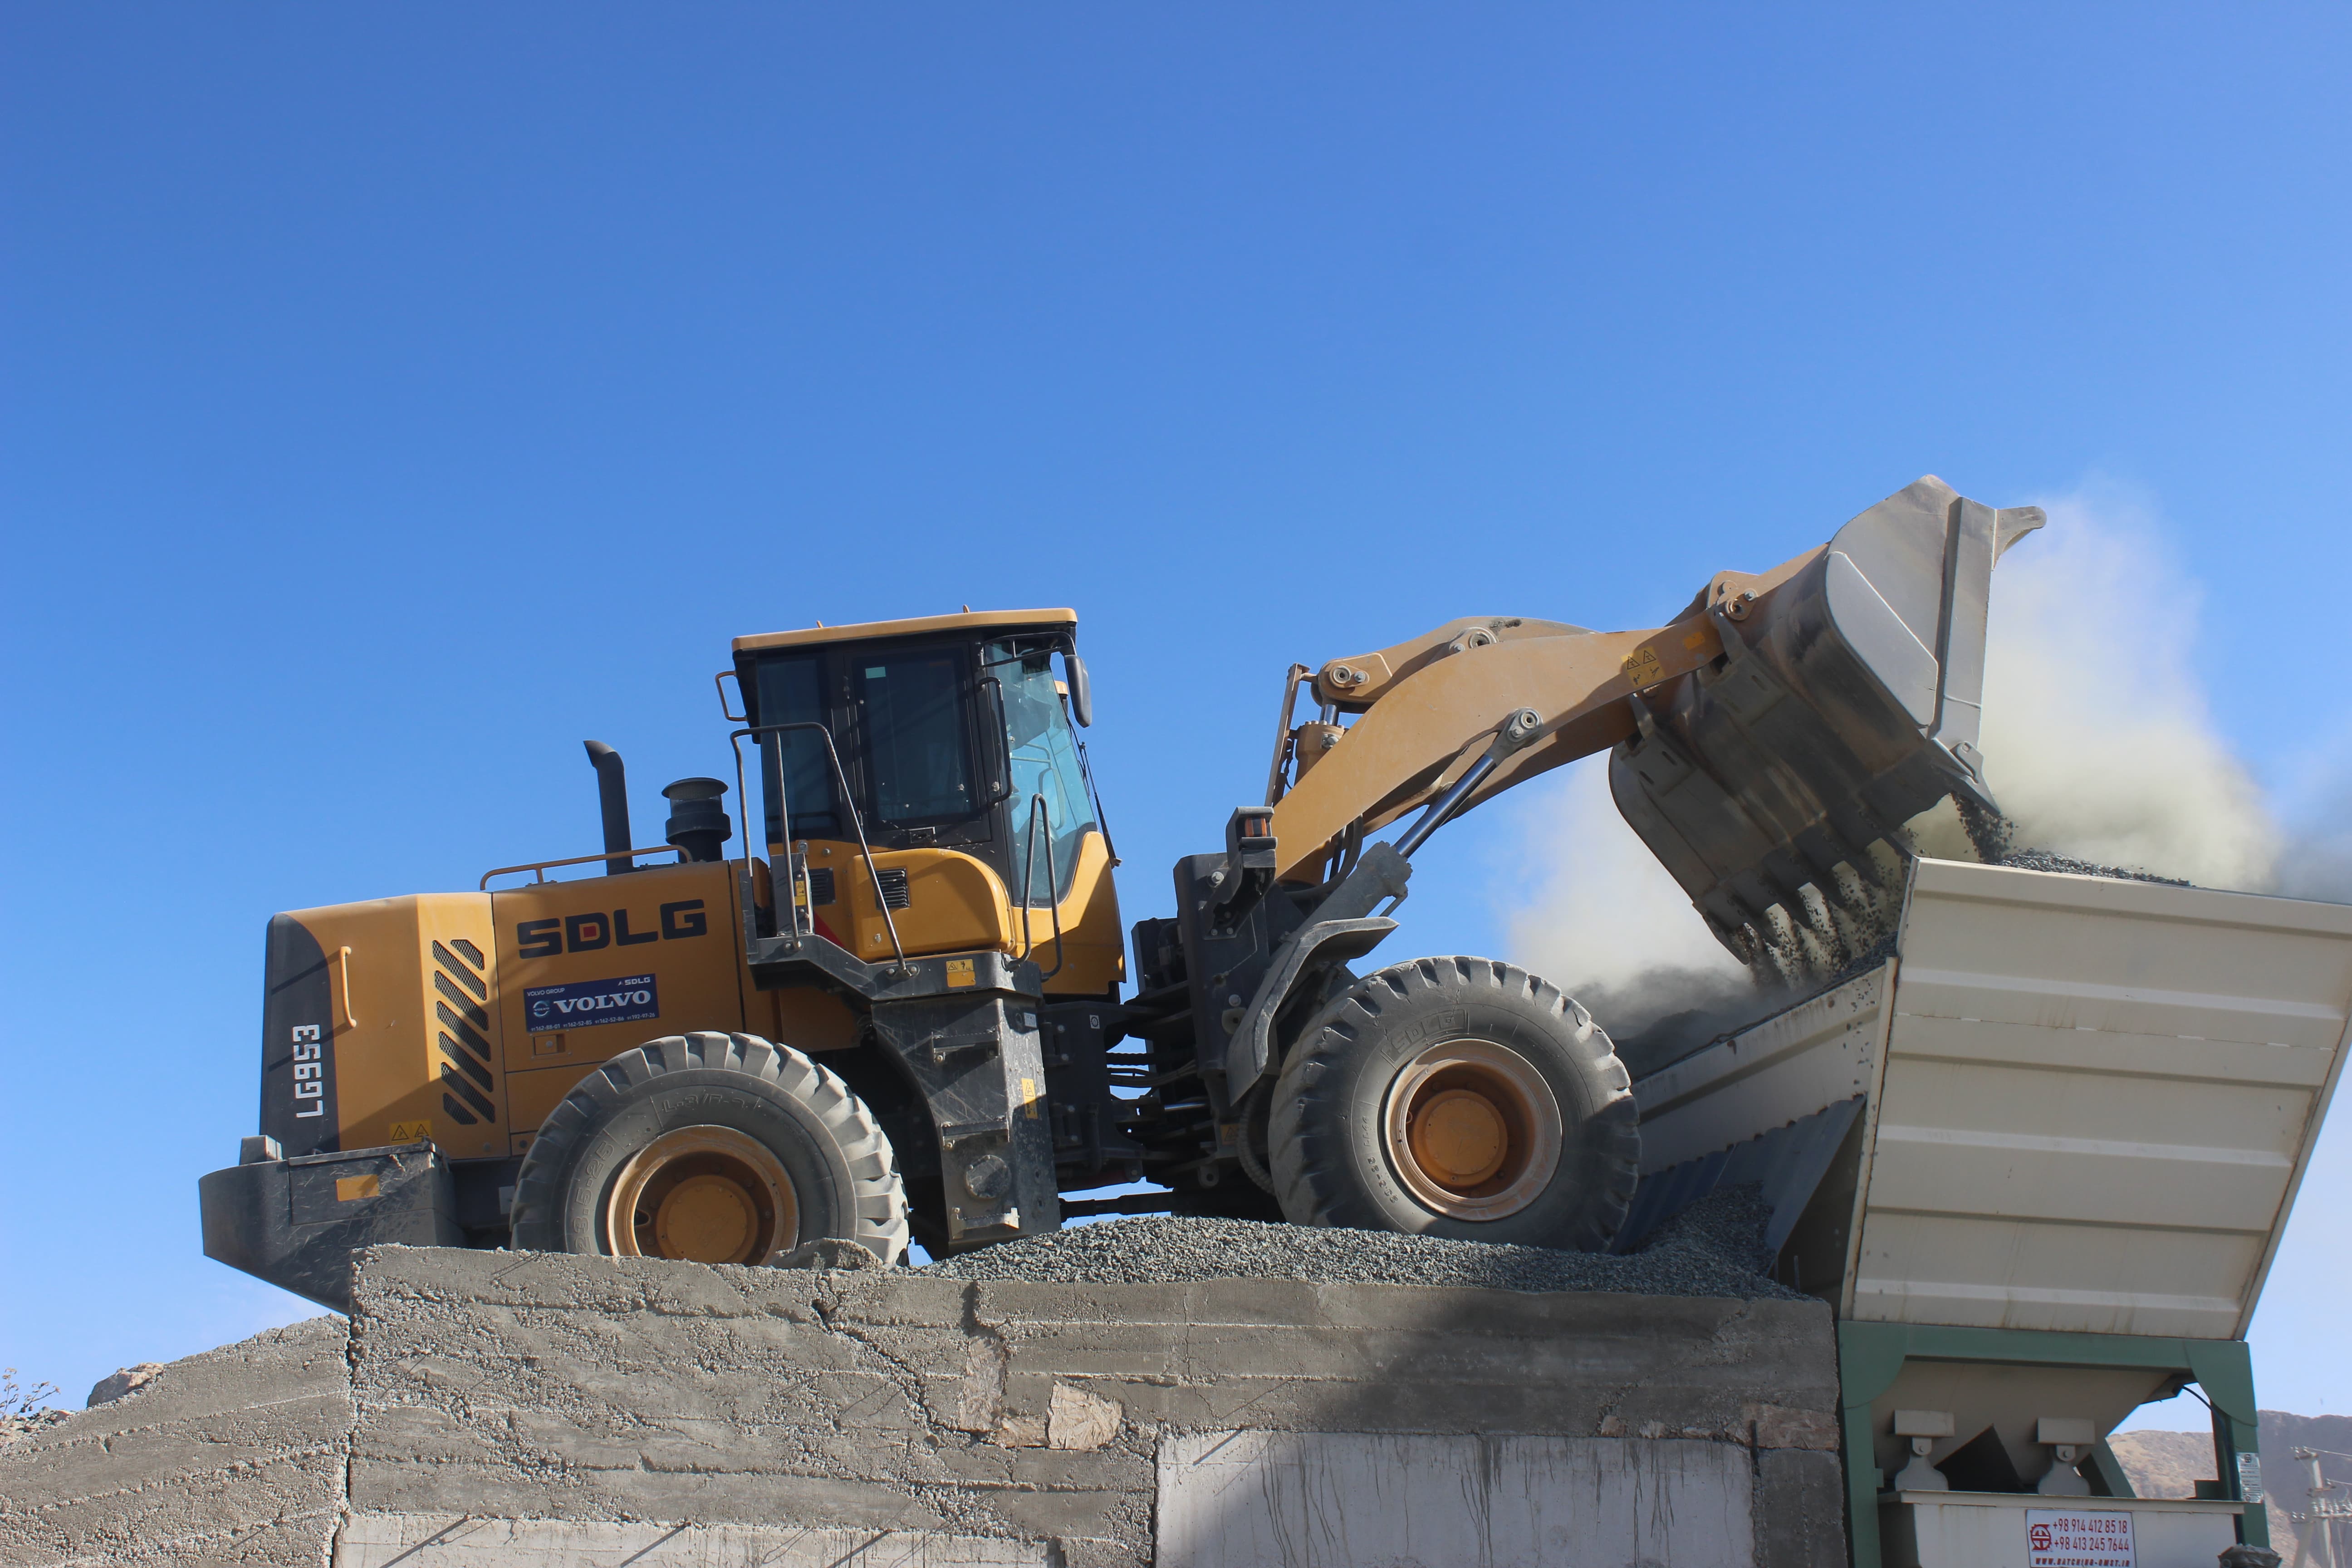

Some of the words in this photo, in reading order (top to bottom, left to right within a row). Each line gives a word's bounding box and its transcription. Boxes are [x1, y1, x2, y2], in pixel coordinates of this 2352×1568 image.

[517, 899, 707, 959] SDLG
[624, 977, 651, 985] SDLG
[554, 990, 651, 1013] VOLVO
[293, 1024, 323, 1118] LG953
[573, 1141, 613, 1253] 23.5-25
[2053, 1519, 2069, 1532] +98
[2072, 1519, 2086, 1533] 914
[2088, 1519, 2102, 1533] 412
[2105, 1520, 2116, 1533] 85
[2118, 1520, 2127, 1534] 18
[2054, 1537, 2070, 1550] +98
[2073, 1537, 2087, 1550] 413
[2089, 1538, 2105, 1551] 245
[2108, 1538, 2129, 1551] 7644
